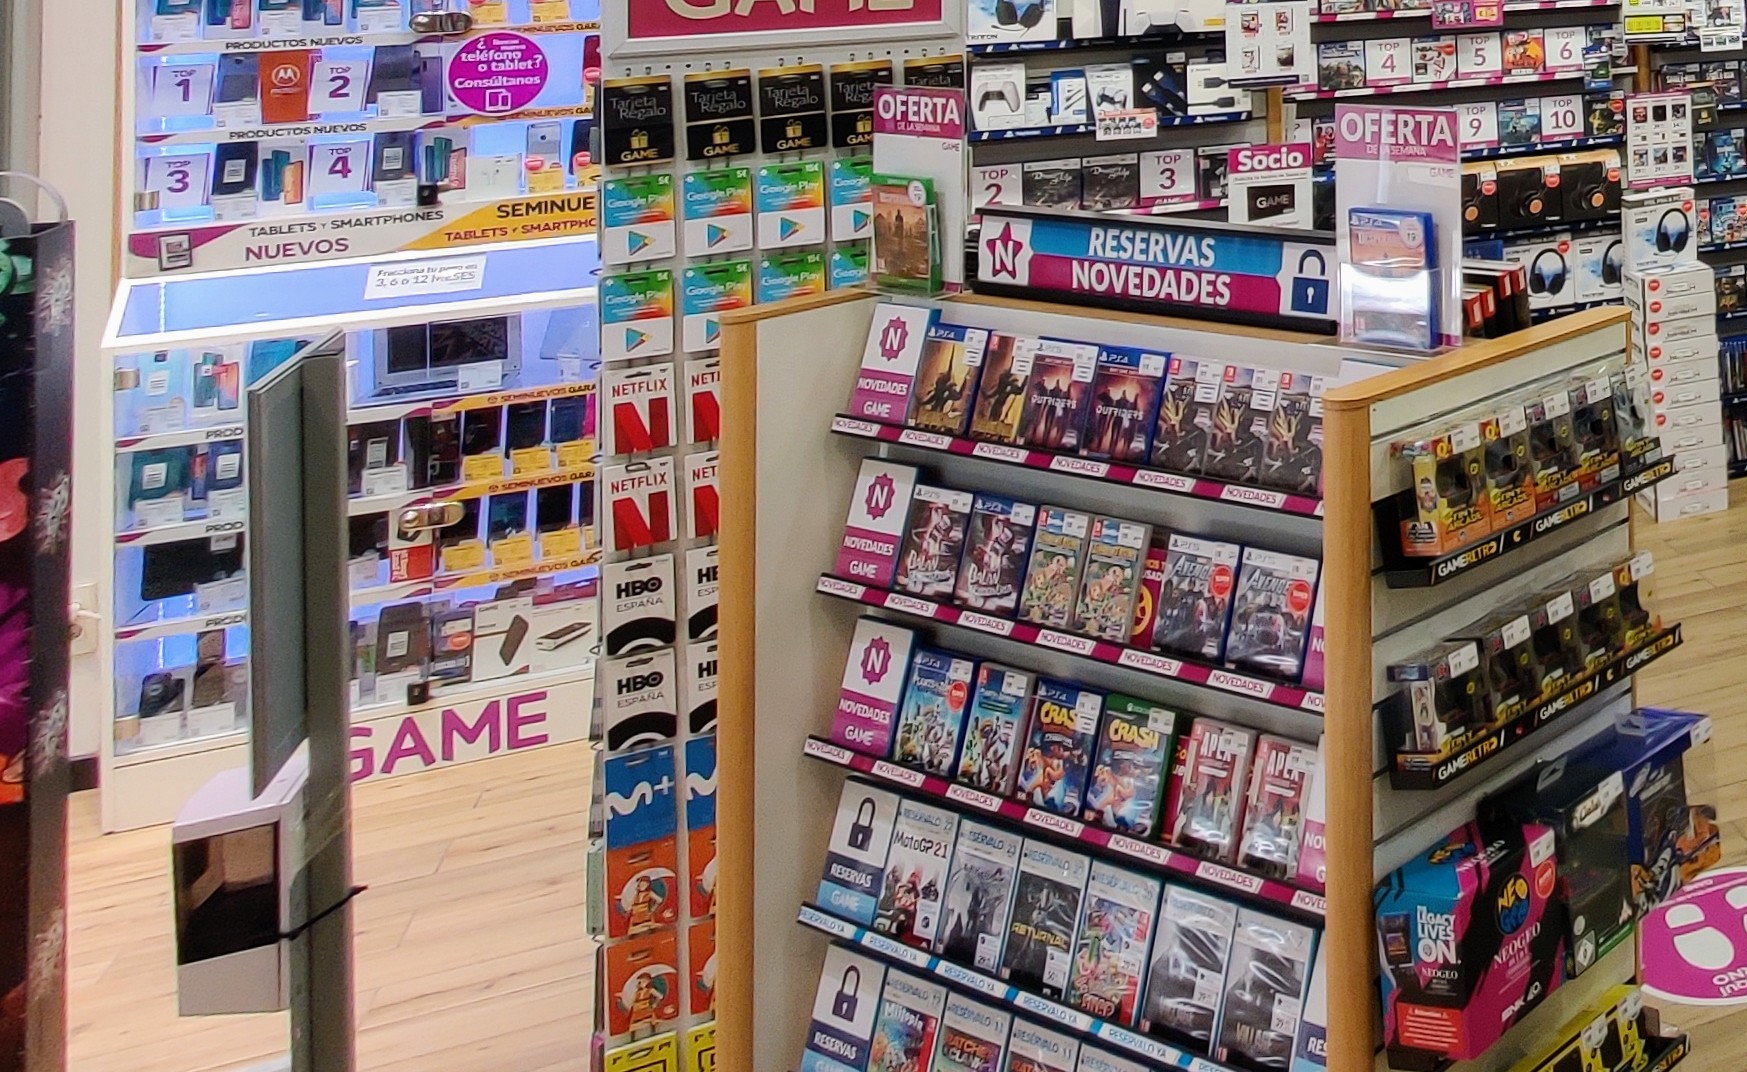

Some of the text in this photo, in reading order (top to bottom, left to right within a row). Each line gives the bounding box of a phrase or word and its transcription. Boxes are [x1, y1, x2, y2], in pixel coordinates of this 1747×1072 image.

[225, 36, 363, 50] PRODUCTOS NUEVOS
[1559, 41, 1572, 60] 6
[490, 54, 543, 72] tablet?
[1380, 54, 1397, 73] 4
[1473, 47, 1486, 66] 5
[176, 80, 189, 101] 1
[329, 76, 350, 97] 2
[764, 83, 809, 103] Tarjeta
[691, 88, 737, 108] Tarjeta
[700, 96, 746, 113] Regalo
[774, 91, 819, 109] Regalo
[1552, 100, 1573, 109] TOP
[619, 102, 667, 119] Regalo
[877, 93, 961, 126] OFERTA
[1466, 106, 1487, 116] TOP
[1549, 110, 1576, 129] 10
[229, 123, 367, 140] PRODUCTOS NUEVOS
[1339, 111, 1455, 148] OFERTA
[1469, 118, 1483, 137] 9
[328, 156, 351, 178] 4
[1153, 153, 1182, 164] TOP
[1237, 147, 1304, 170] Socio
[167, 170, 189, 193] 3
[979, 169, 1009, 179] TOP
[1159, 167, 1176, 189] 3
[686, 189, 726, 202] Google
[760, 180, 819, 195] Google Play
[982, 183, 1003, 205] 2
[497, 196, 595, 219] SEMINUE
[249, 210, 444, 237] TABLETS SMARTPHONES
[445, 227, 508, 242] TABLETS
[245, 239, 349, 261] NUEVOS
[1088, 227, 1216, 266] RESERVAS
[1072, 261, 1232, 306] NOVEDADES
[611, 378, 668, 398] NETFLIX
[858, 377, 908, 396] NOVEDADES
[1031, 392, 1077, 411] OUTRIDERS
[1095, 404, 1144, 422] OUTRIDERS
[610, 472, 668, 494] NETFLIX
[1226, 488, 1278, 505] NOVEDADES
[843, 535, 894, 556] NOVEDADES
[616, 577, 663, 599] HBO
[616, 597, 663, 613] ESPAÑA
[1124, 650, 1173, 671] NOVEDADES
[616, 670, 664, 696] HBO
[1212, 672, 1265, 693] NOVEDADES
[617, 691, 665, 708] ESPAÑA
[839, 698, 891, 724] NOVEDADES
[1109, 719, 1159, 748] CRASH
[894, 831, 948, 859] MotoGP 21
[1112, 837, 1162, 860] NOVEDADES
[830, 862, 873, 888] RESERVAS
[1201, 865, 1254, 888] NOVEDADES
[1499, 878, 1528, 910] NEO
[1011, 922, 1069, 949] RETURNAL
[1417, 924, 1455, 940] LIVES
[1421, 967, 1458, 979] NEOGEO
[813, 1033, 858, 1060] RESERVAS
